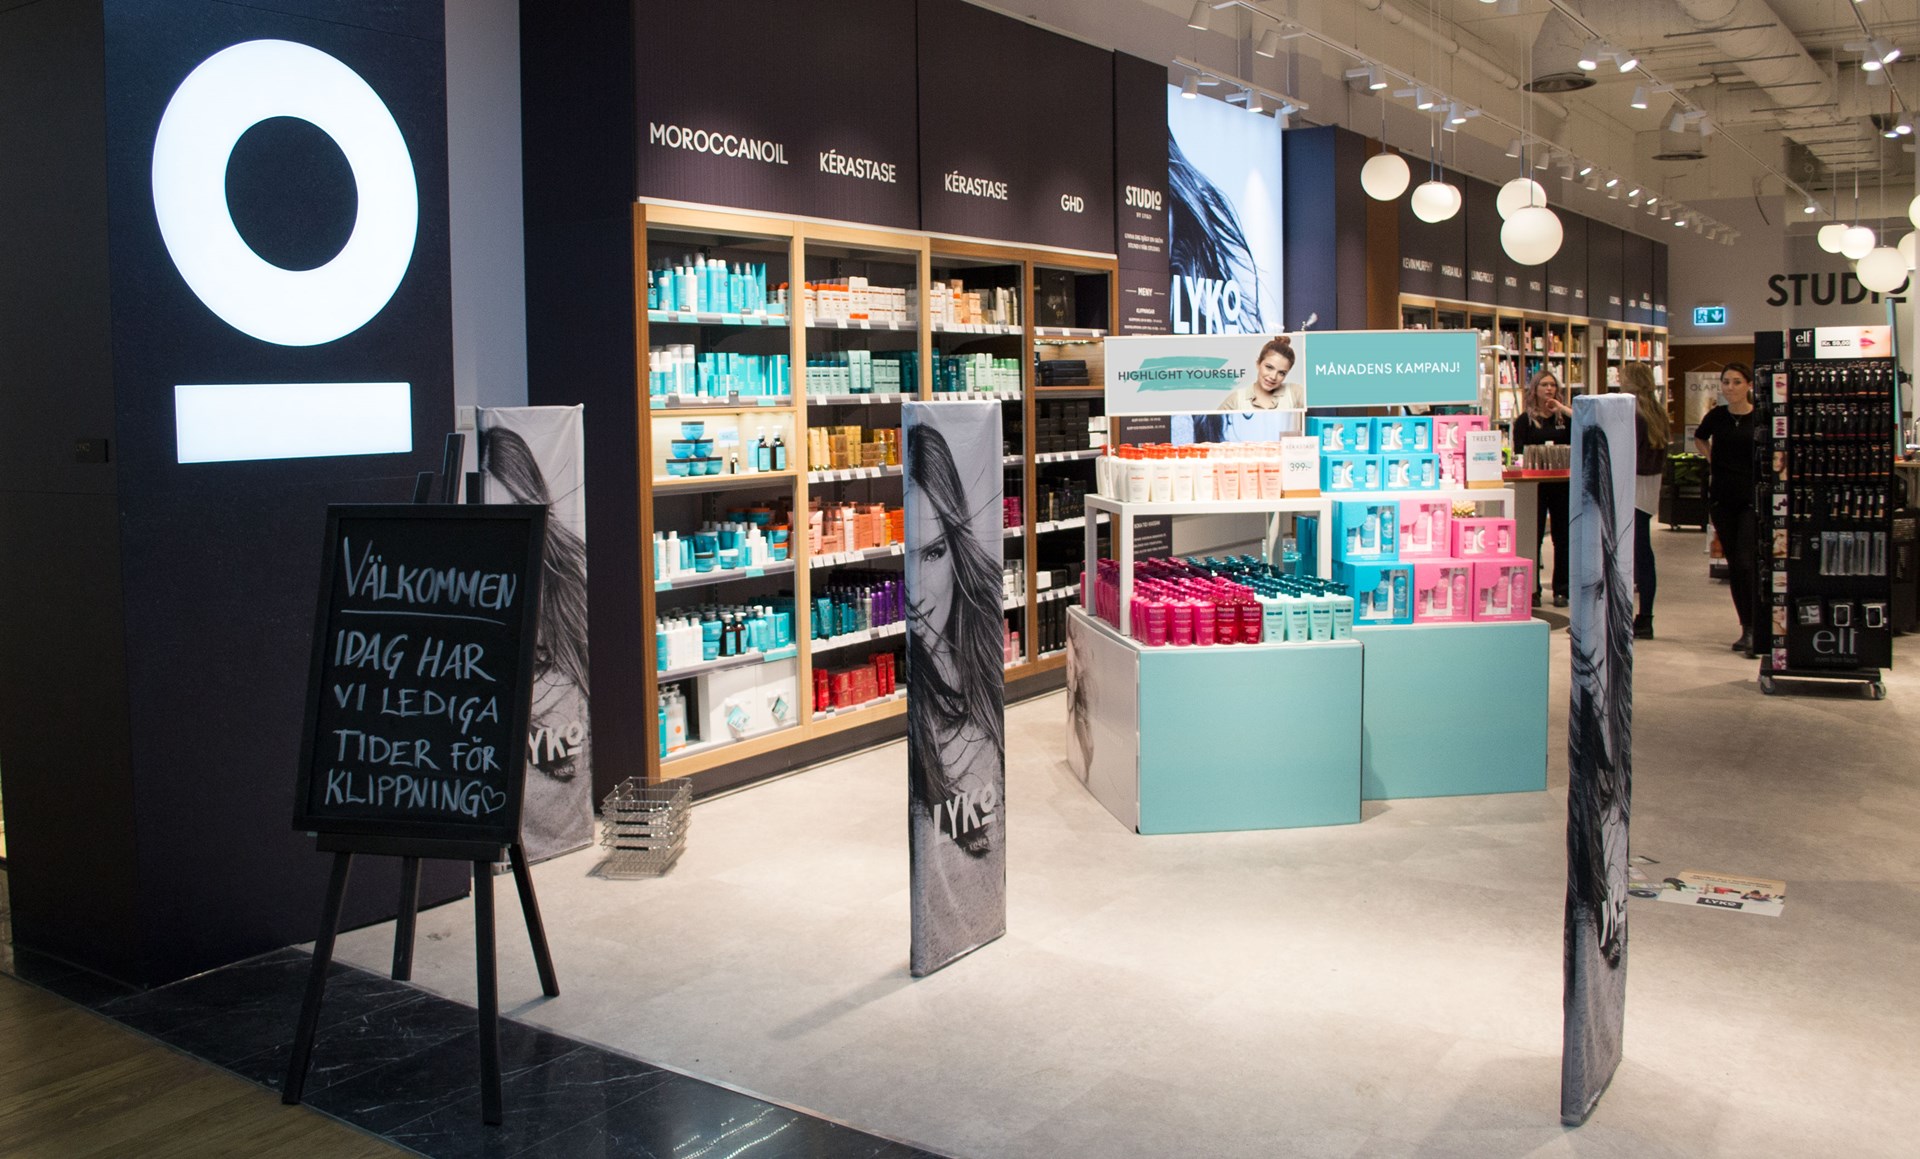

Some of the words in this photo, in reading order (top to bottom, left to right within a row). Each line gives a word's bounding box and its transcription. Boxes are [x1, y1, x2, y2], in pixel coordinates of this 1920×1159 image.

[650, 122, 789, 165] MOROCCANOIL
[819, 149, 897, 184] KÉRASTASE
[944, 170, 1008, 200] KÉRASTASE
[1125, 185, 1162, 211] STUDIO
[1060, 194, 1084, 213] GHD
[1137, 286, 1153, 297] MENY
[1173, 274, 1242, 334] LYKO
[1766, 272, 1910, 307] STUD
[1118, 370, 1183, 381] HIGHLIGHT
[1186, 369, 1246, 380] YOURSELF
[1315, 361, 1393, 376] MÅNADENS
[1396, 362, 1461, 374] KAMPANJ!
[1690, 383, 1720, 392] OLAPL
[343, 536, 517, 610] VÄLKOMMEN
[334, 629, 408, 680] IDAG
[417, 636, 496, 682] HAR
[334, 683, 366, 711] VI
[381, 687, 498, 735] LEDIGA
[333, 729, 441, 771] TIDER
[450, 735, 500, 774] FÖR
[528, 720, 584, 766] YKO
[325, 768, 481, 818] KLIPPNING
[933, 782, 997, 846] LYKO
[1705, 898, 1736, 908] LYKO
